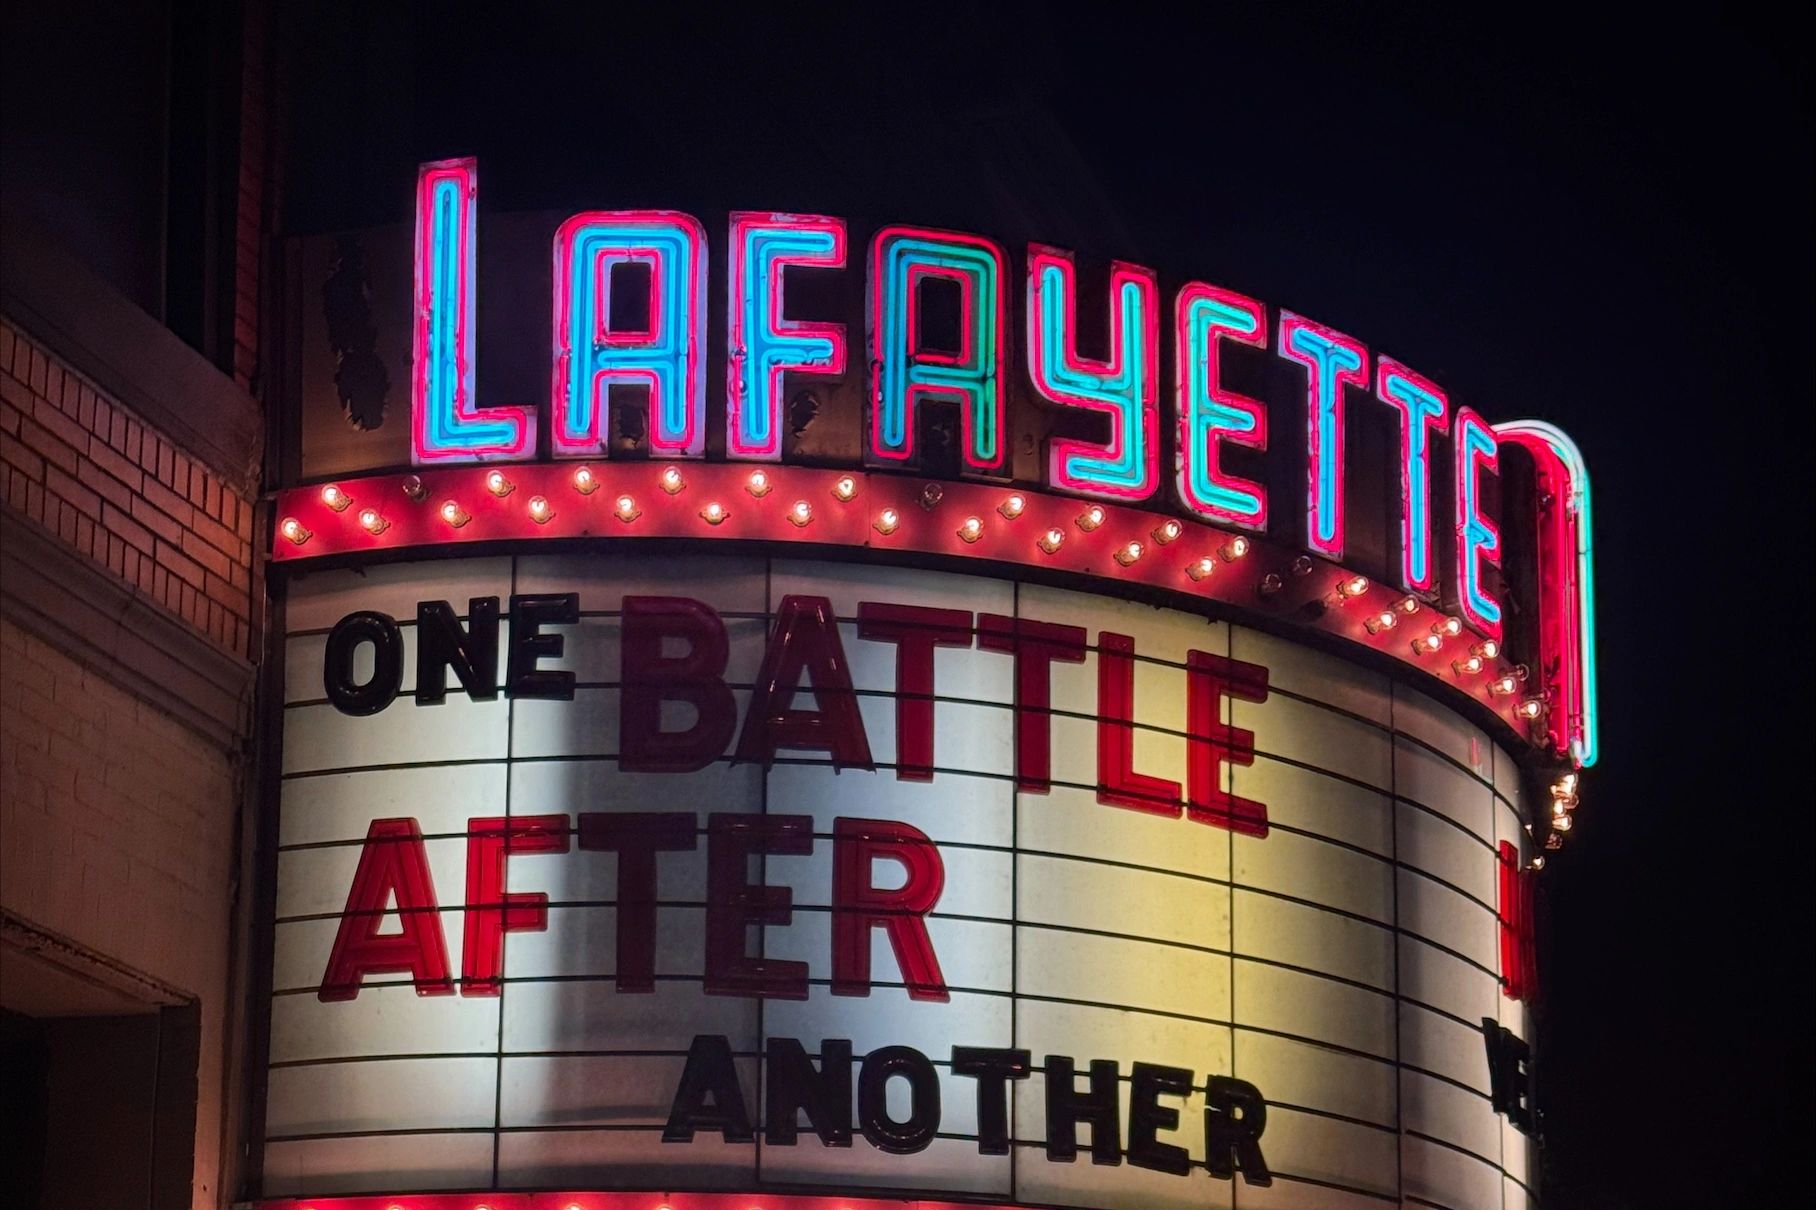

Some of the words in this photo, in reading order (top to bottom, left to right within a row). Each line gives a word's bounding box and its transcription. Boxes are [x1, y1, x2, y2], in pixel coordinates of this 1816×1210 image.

[411, 156, 1502, 639] LAFAYETTE
[324, 592, 579, 716] ONE
[618, 594, 1270, 839] BATTLE
[318, 813, 951, 1003] AFTER
[661, 1033, 1274, 1187] ANOTHER
